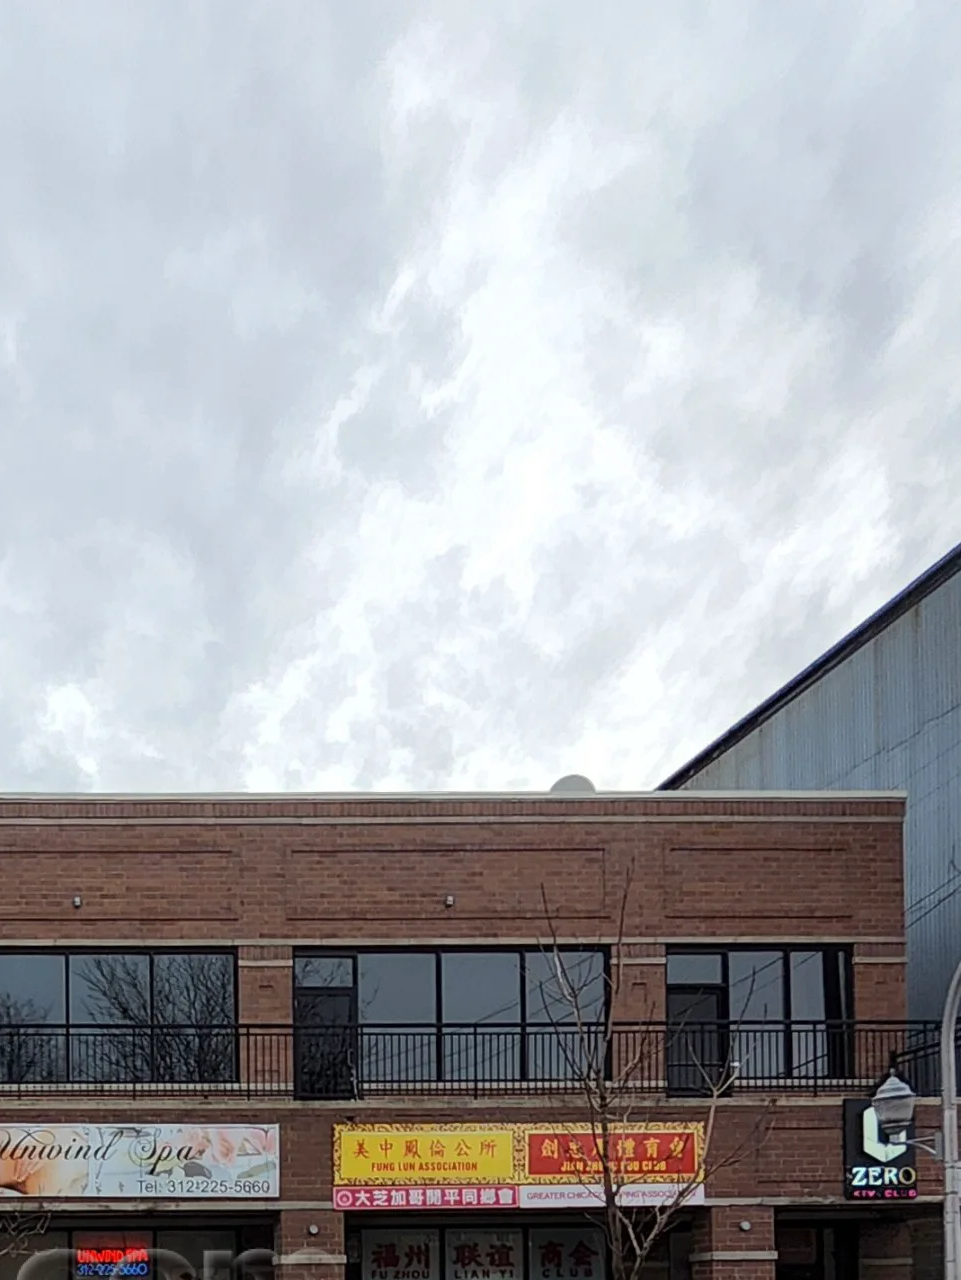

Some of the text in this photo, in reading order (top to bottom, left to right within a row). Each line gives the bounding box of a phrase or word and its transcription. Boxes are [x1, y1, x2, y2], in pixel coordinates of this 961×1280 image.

[130, 1128, 198, 1176] Spa
[371, 1161, 478, 1172] FUNG LUN ASSOCIATION
[851, 1166, 917, 1186] ZERO
[138, 1180, 270, 1194] Tel: 312-225-5660
[526, 1190, 566, 1201] GREATER
